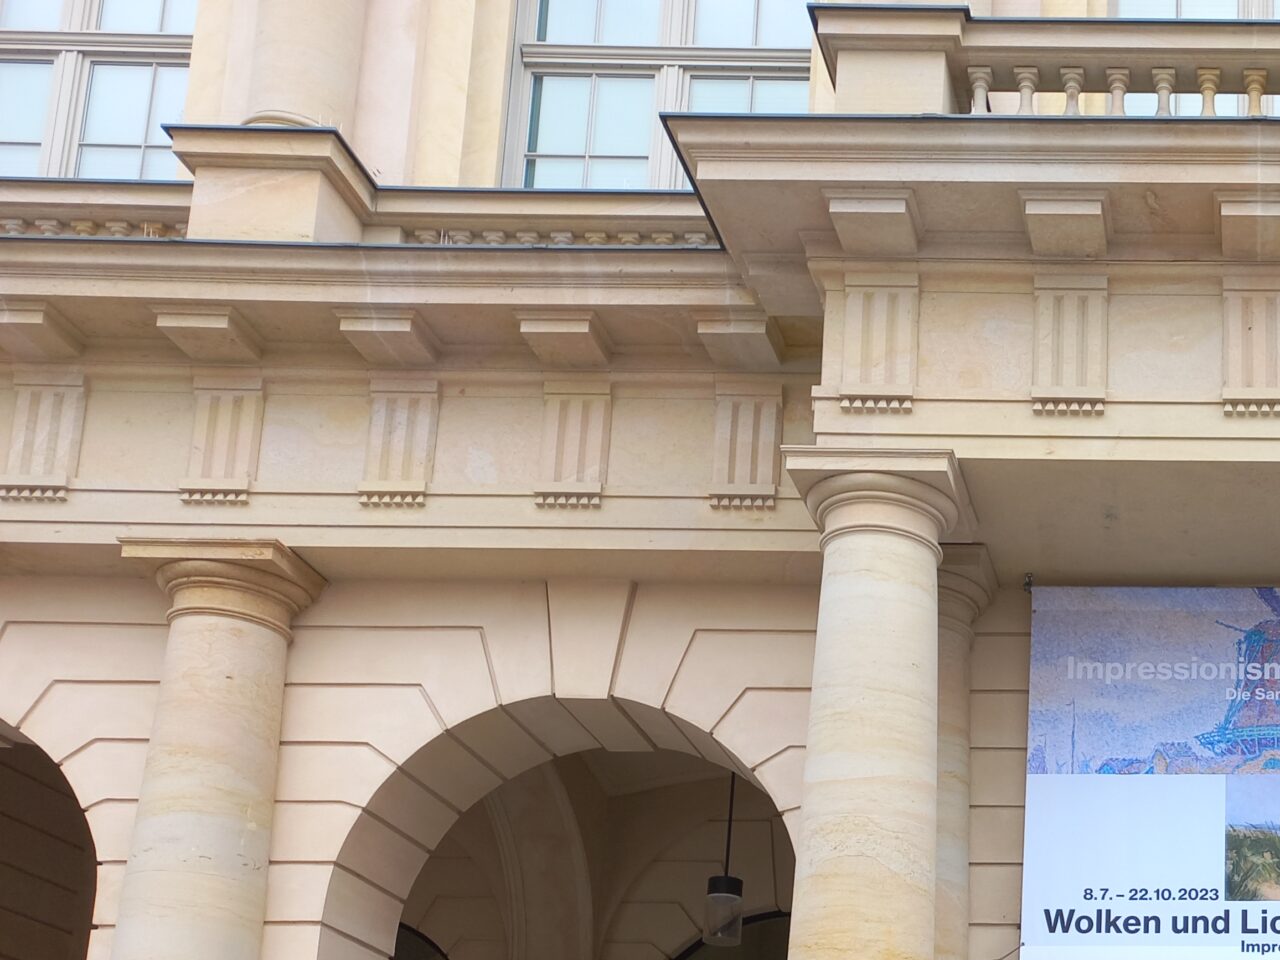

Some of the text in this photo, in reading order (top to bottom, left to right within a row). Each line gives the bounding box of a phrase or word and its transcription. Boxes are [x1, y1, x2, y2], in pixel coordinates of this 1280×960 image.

[1225, 687, 1250, 701] Die
[1044, 908, 1161, 935] Wolken
[1171, 909, 1230, 935] und
